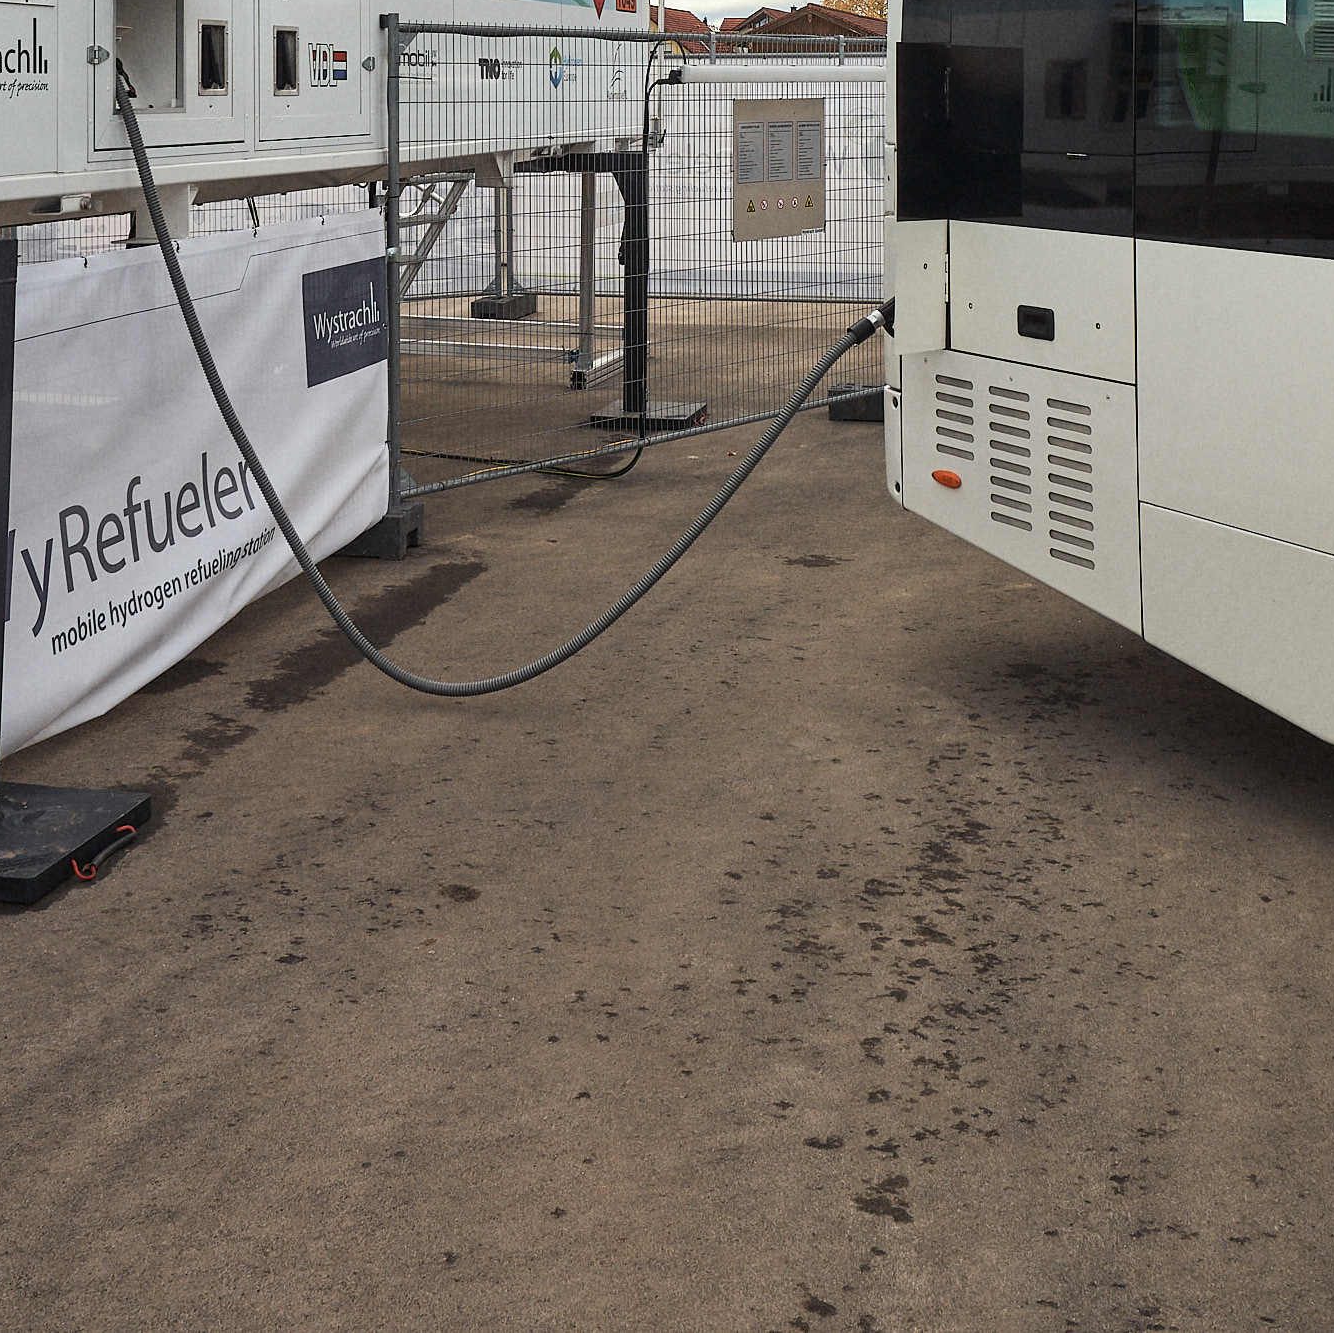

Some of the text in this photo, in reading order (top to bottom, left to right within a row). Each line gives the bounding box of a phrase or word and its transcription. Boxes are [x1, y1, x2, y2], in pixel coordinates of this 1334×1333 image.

[308, 42, 338, 87] VDL
[7, 78, 18, 99] of
[16, 80, 49, 97] precision
[313, 299, 371, 344] Wystrach
[5, 452, 257, 637] yRefueler
[51, 525, 276, 655] mobile hydrogen refueling station
